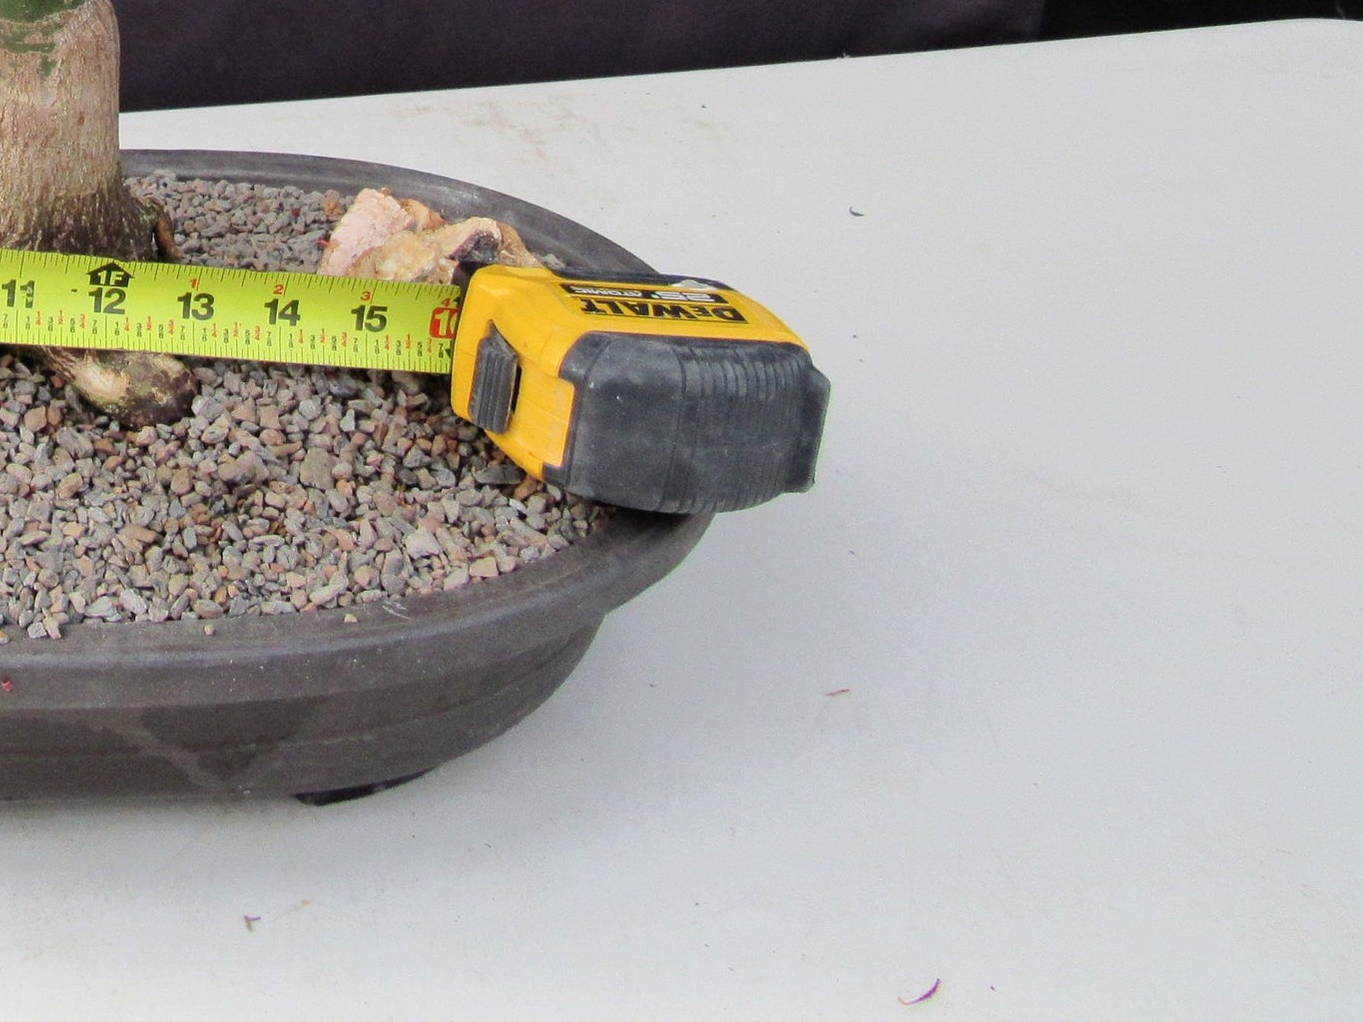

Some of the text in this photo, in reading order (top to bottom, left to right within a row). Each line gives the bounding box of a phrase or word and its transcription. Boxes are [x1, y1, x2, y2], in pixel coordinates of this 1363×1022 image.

[98, 269, 125, 286] 1F
[273, 284, 285, 295] 2
[1, 279, 36, 309] 11
[88, 287, 127, 315] 12
[177, 292, 215, 321] 13
[360, 290, 372, 301] 3
[441, 297, 451, 307] 4
[264, 298, 301, 327] 14
[351, 303, 388, 333] 15
[581, 298, 747, 323] DEWALT
